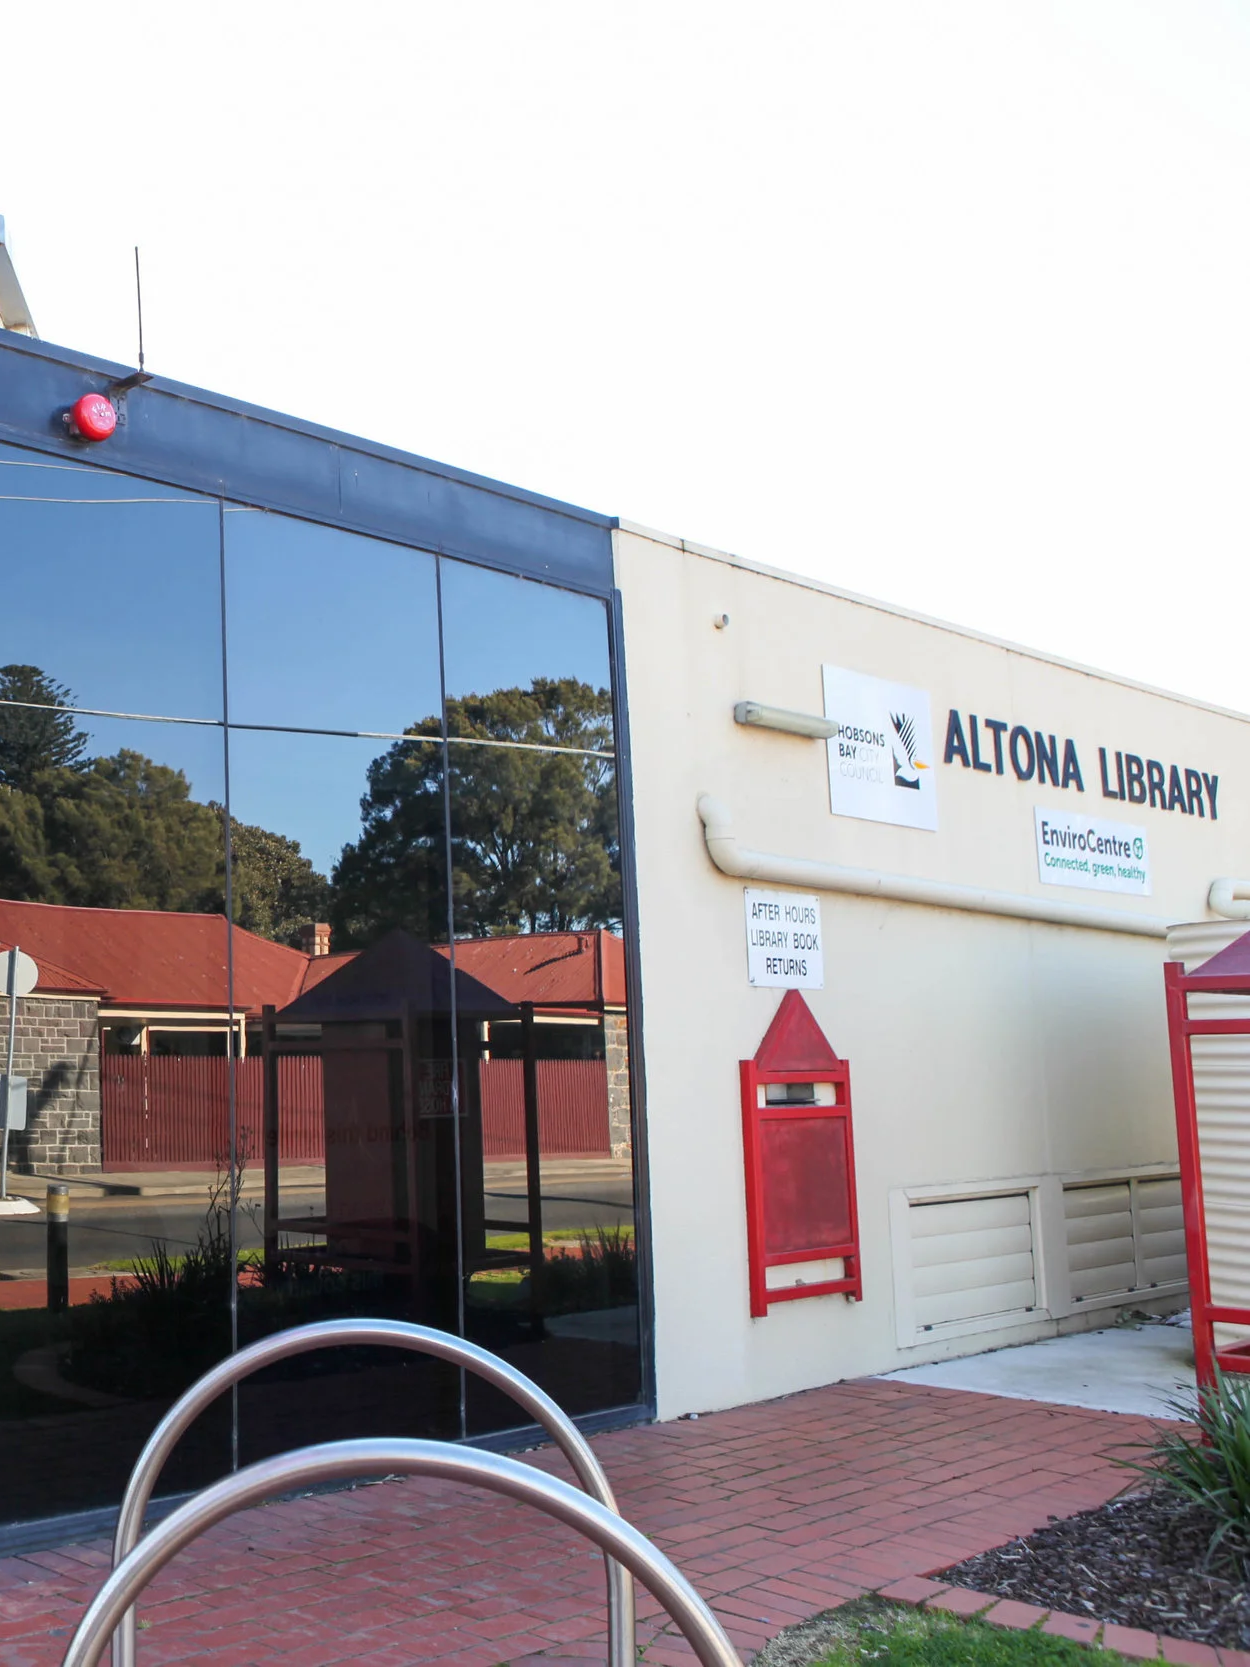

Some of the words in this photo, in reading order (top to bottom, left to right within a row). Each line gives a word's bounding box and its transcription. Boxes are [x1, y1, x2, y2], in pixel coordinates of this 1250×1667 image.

[838, 724, 885, 747] HOBSONS
[839, 743, 857, 759] BAY
[840, 761, 884, 784] COUNCIL
[944, 709, 1084, 792] ALTONA
[1098, 747, 1219, 821] LIBRARY
[1041, 820, 1131, 859] EnviroCentre
[1044, 852, 1091, 873] Connected,
[1092, 862, 1116, 878] green,
[1117, 863, 1146, 884] healthy
[751, 902, 780, 921] AFTER
[784, 905, 816, 925] HOURS
[750, 929, 789, 948] LIBRARY
[793, 933, 819, 951] BOOK
[766, 957, 807, 976] RETURNS
